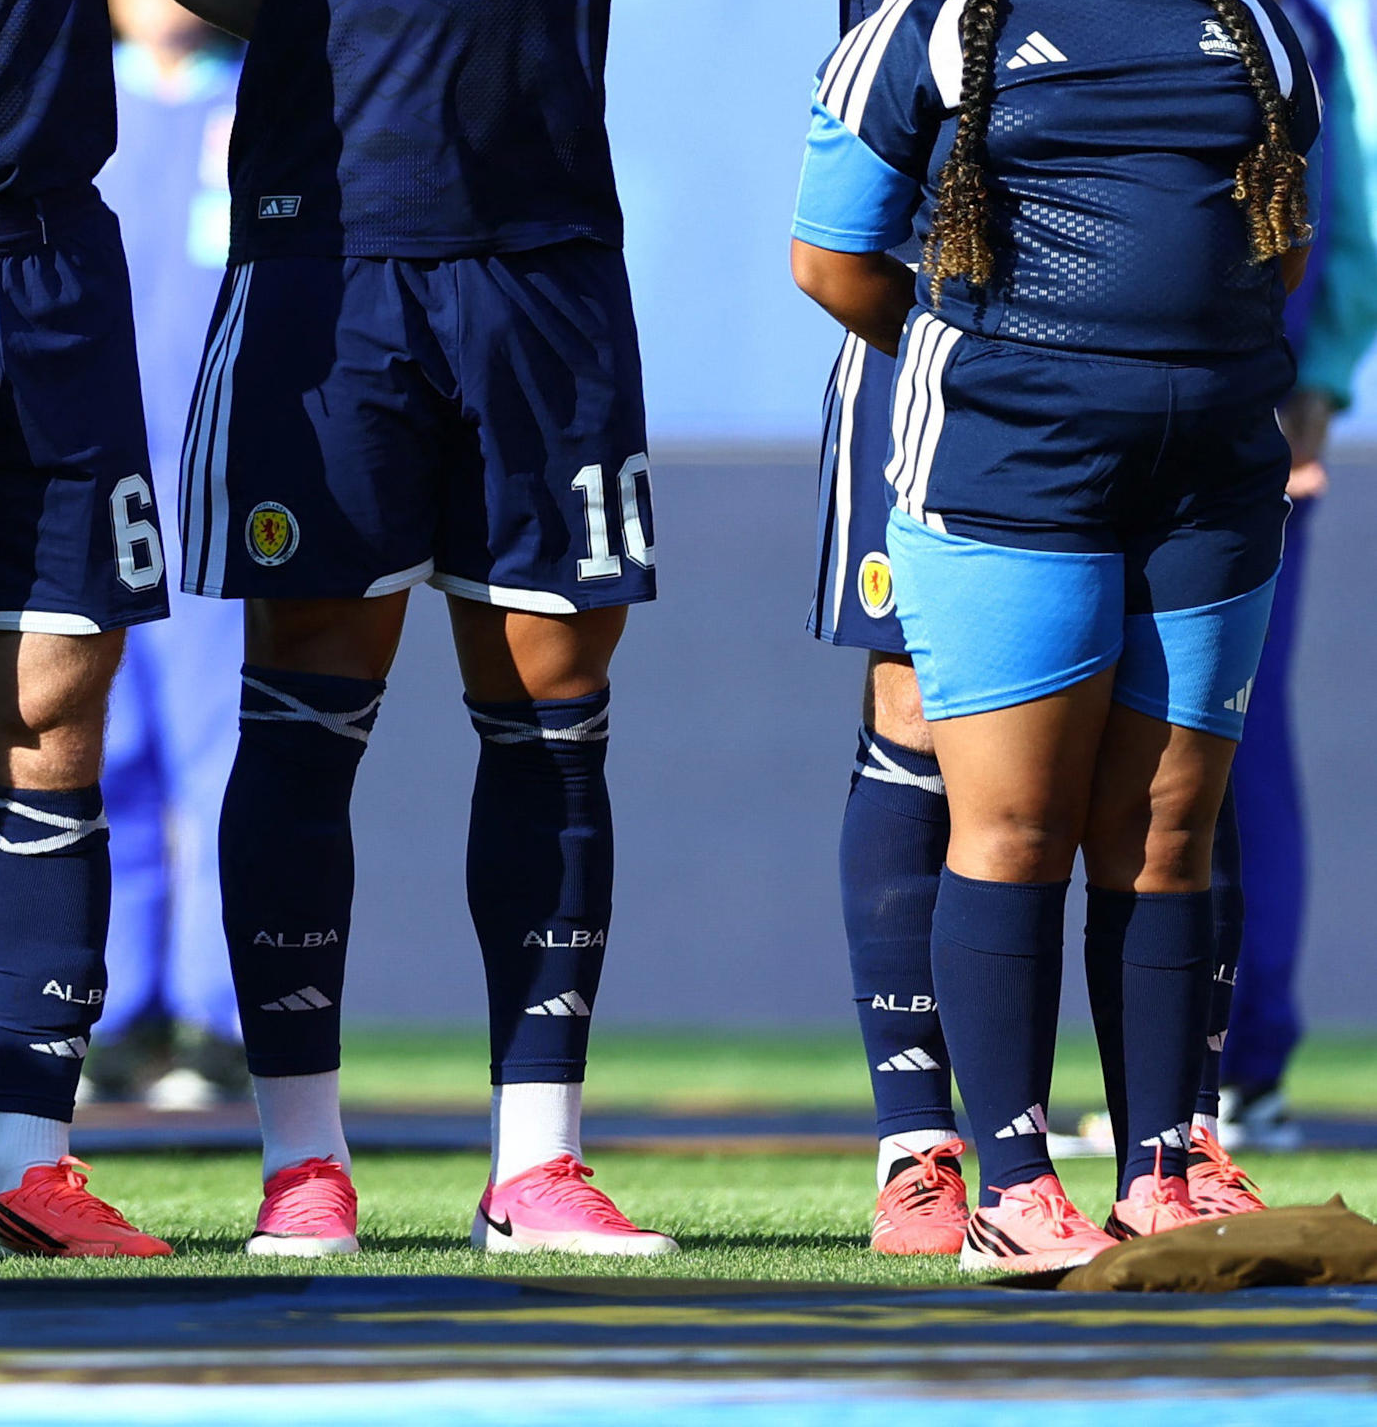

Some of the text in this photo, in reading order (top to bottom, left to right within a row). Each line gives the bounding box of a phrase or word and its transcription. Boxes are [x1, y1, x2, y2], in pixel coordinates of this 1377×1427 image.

[571, 452, 655, 581] 10
[109, 474, 164, 593] 6
[254, 929, 338, 947] ALBA
[523, 930, 604, 948] ALBA
[42, 980, 105, 1005] ALB
